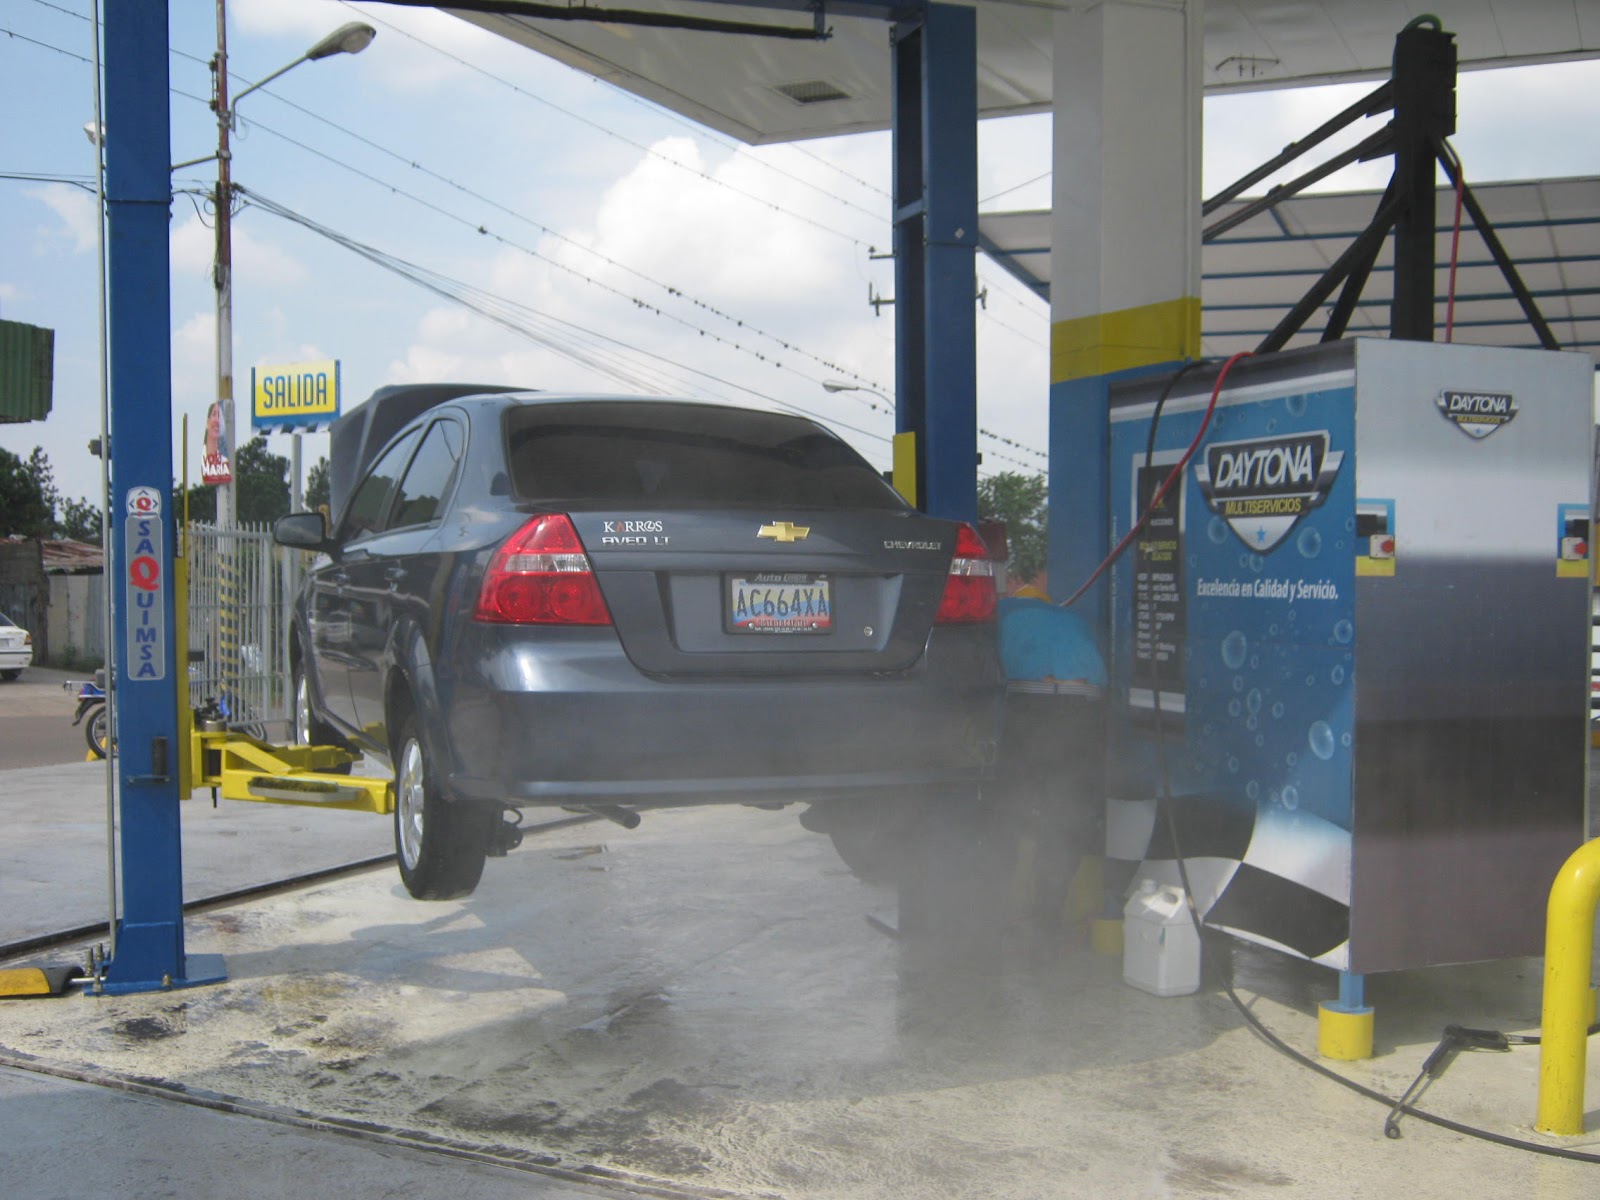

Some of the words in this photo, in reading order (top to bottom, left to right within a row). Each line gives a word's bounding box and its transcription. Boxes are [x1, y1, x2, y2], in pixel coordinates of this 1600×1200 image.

[263, 372, 327, 409] SALIDA
[1450, 394, 1507, 413] DAYTONA
[1214, 444, 1313, 488] DAYTONA
[1225, 498, 1302, 516] MULTISERVICIOS
[602, 536, 647, 546] AVEO
[654, 536, 671, 546] LT
[884, 540, 942, 550] CHEVROLET
[755, 573, 781, 582] Auto
[129, 520, 160, 678] SAQUIMSA
[1197, 578, 1239, 598] Excelencia
[1241, 581, 1252, 598] en
[1254, 578, 1289, 598] Calidad
[1289, 583, 1297, 602] y
[1297, 579, 1339, 600] Servicio.
[737, 588, 828, 617] AC664XA
